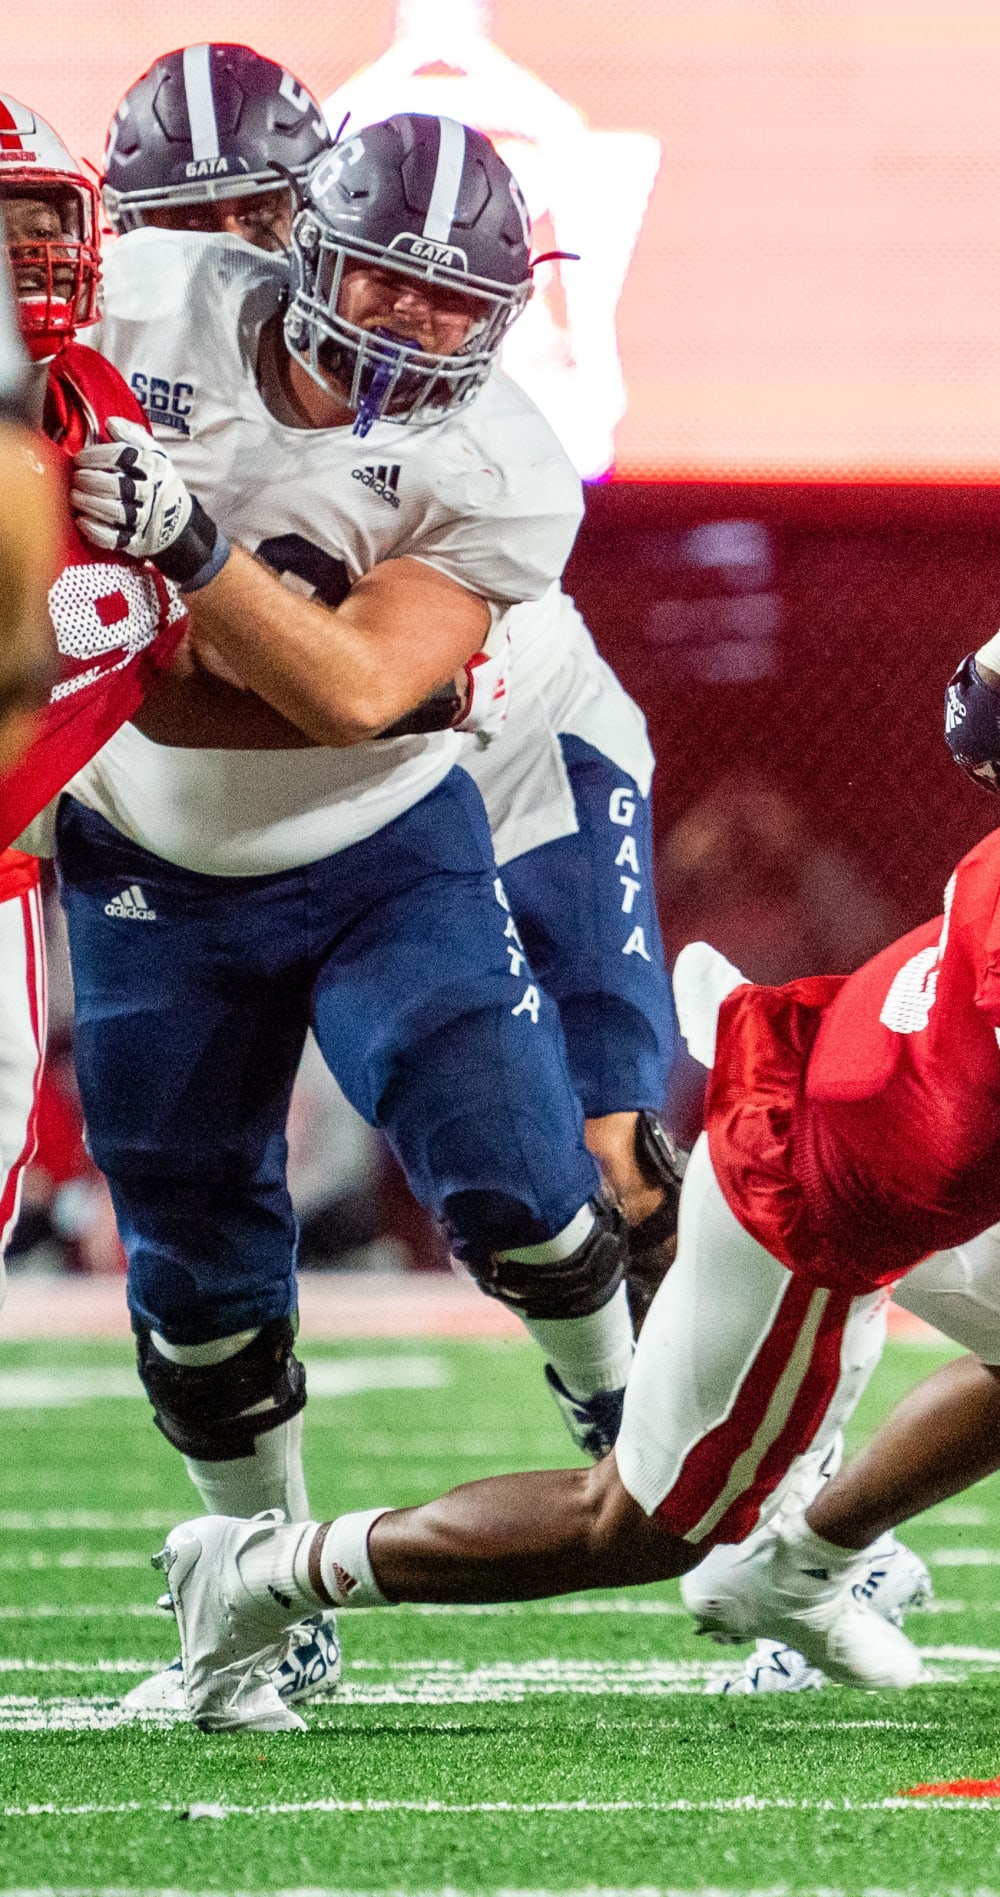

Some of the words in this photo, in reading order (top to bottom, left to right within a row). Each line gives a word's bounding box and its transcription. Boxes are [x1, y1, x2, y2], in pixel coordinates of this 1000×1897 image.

[186, 157, 229, 178] GATA
[409, 240, 454, 266] GATA
[131, 372, 194, 415] SBC
[351, 468, 401, 509] adidas
[609, 787, 651, 963] GATA
[104, 903, 157, 920] adidas
